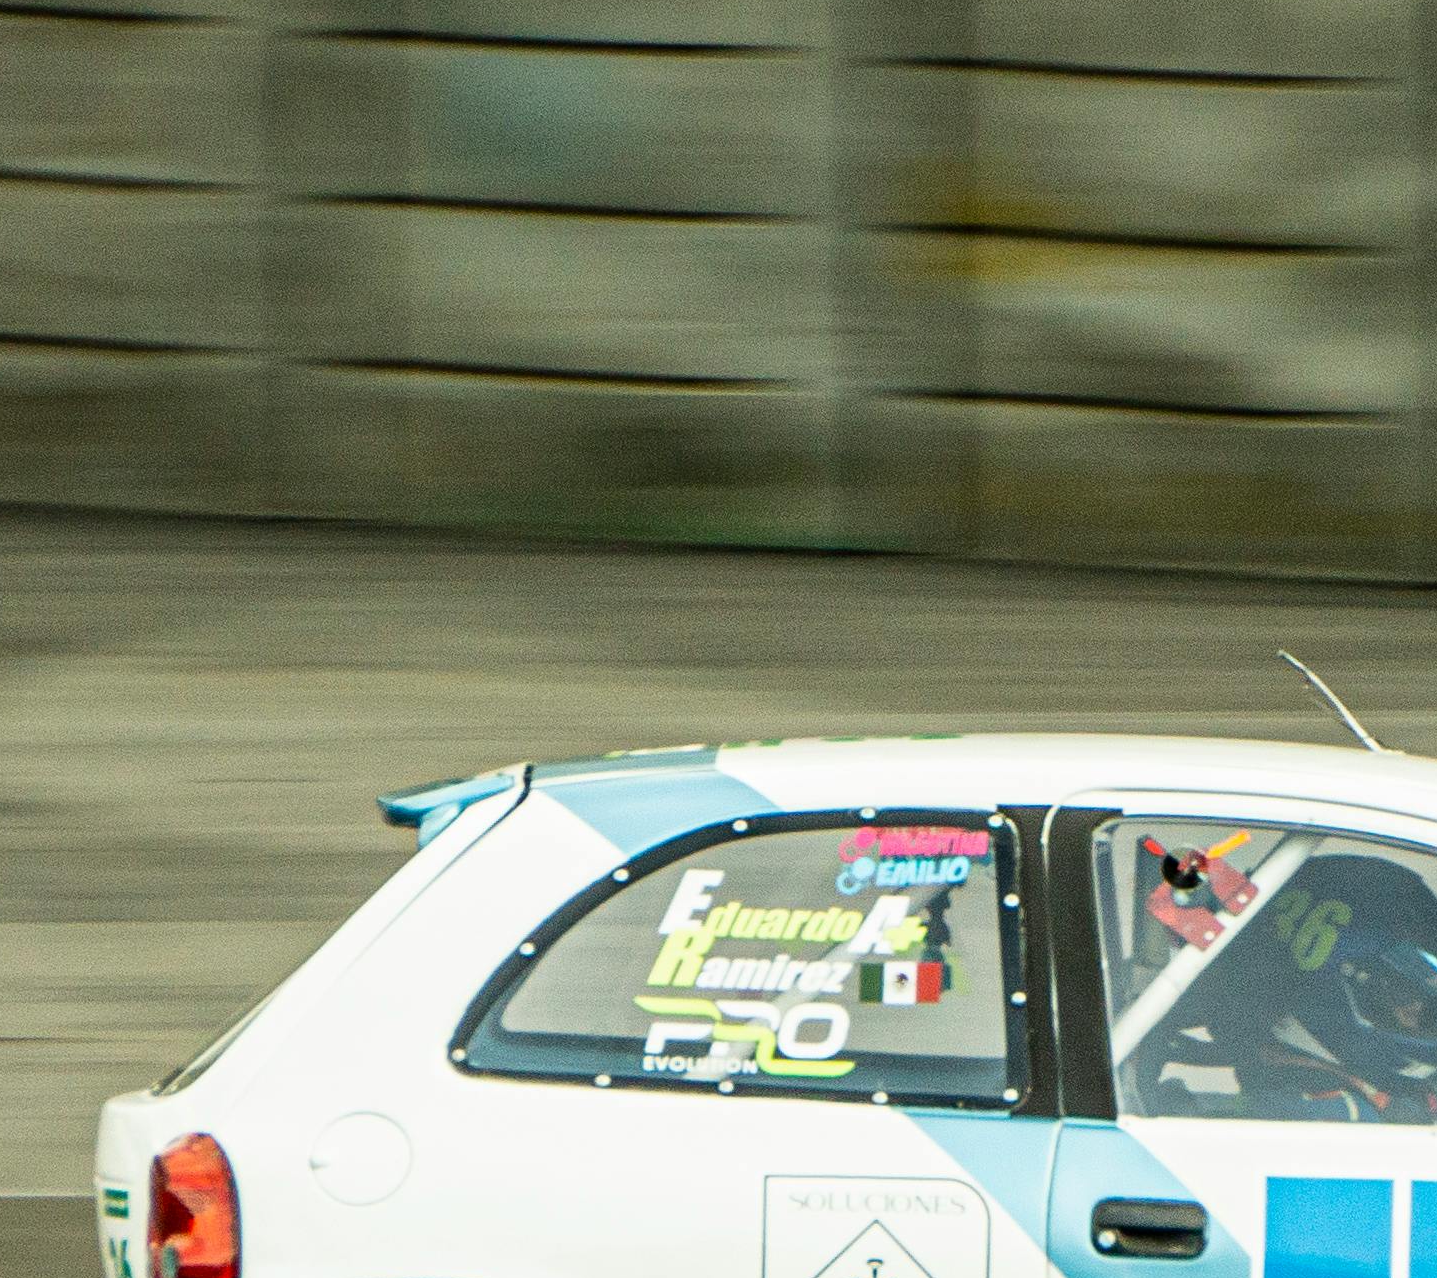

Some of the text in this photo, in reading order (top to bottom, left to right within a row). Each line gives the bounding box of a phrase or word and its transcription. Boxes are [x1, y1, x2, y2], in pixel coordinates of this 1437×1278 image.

[876, 857, 970, 886] EMILIO
[659, 869, 863, 942] Eduardo
[647, 929, 853, 994] Ramirez
[788, 1192, 966, 1215] SOLUCIONES
